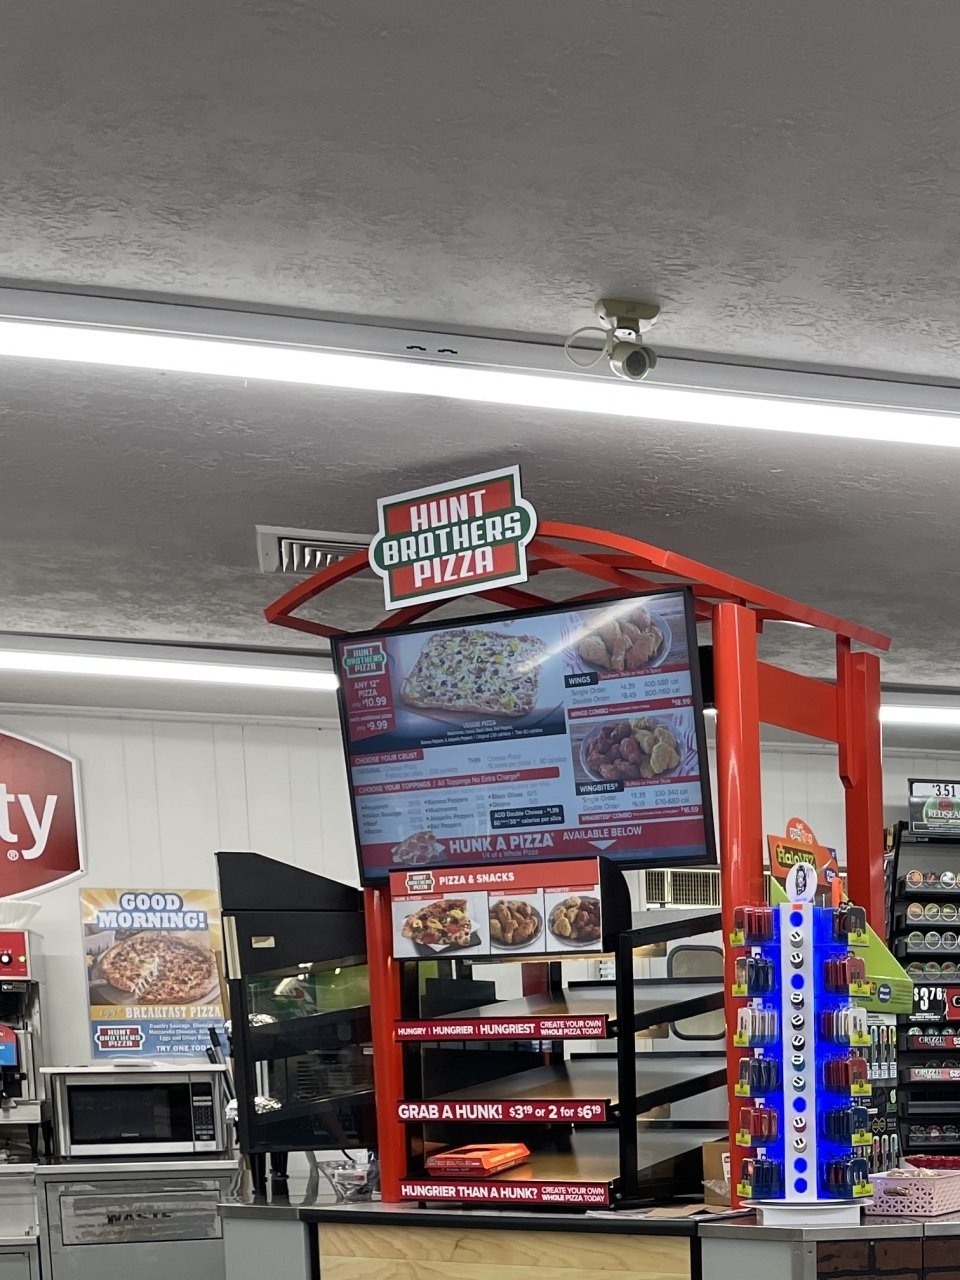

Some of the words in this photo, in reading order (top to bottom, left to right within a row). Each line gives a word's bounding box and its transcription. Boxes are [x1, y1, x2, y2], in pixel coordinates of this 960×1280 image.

[410, 490, 486, 532] HUNT
[382, 512, 521, 566] BROTHERS
[413, 546, 494, 588] PIZZA
[354, 682, 368, 690] ANY
[568, 675, 591, 685] WINGS
[358, 689, 378, 698] PIZZA
[355, 756, 380, 765] CHOOSE
[380, 754, 397, 763] YOUR
[397, 752, 418, 760] CRUST
[359, 786, 383, 794] CHOOSE
[384, 784, 401, 792] YOUR
[401, 782, 431, 791] TOPPINGS
[471, 775, 481, 783] No
[481, 774, 496, 783] Extra
[450, 837, 493, 854] HUNK
[495, 835, 508, 851] A
[510, 832, 554, 849] PIZZA
[562, 828, 610, 841] AVAILABLE
[611, 825, 642, 838] BELOW
[439, 875, 466, 886] PIZZA
[467, 874, 475, 884] &
[476, 871, 515, 883] SNACKS
[121, 893, 181, 911] GOOD
[98, 912, 206, 928] MORNING!
[125, 1006, 187, 1019] BREAKFAST
[190, 1006, 222, 1018] PIZZA
[398, 1026, 427, 1036] HUNGRY
[432, 1025, 474, 1036] HUNGRIER
[480, 1023, 536, 1035] HUNGRIEST
[540, 1021, 565, 1029] CREATE
[565, 1020, 584, 1028] YOUR
[584, 1020, 602, 1028] OWN
[540, 1028, 563, 1036] WHOLE
[563, 1028, 581, 1036] PIZZA
[581, 1027, 602, 1035] TODAY
[398, 1104, 440, 1119] GRAB
[441, 1105, 454, 1119] A
[455, 1104, 503, 1119] HUNK!
[535, 1108, 546, 1117] or
[548, 1106, 558, 1119] 2
[560, 1107, 575, 1117] for
[400, 1184, 456, 1198] HUNGRIER
[457, 1186, 489, 1199] THAN
[489, 1187, 500, 1198] A
[500, 1187, 538, 1199] HUNK?
[541, 1186, 567, 1195] CREATE
[567, 1187, 586, 1195] YOUR
[586, 1187, 604, 1195] OWN
[583, 1194, 605, 1202] TODAY
